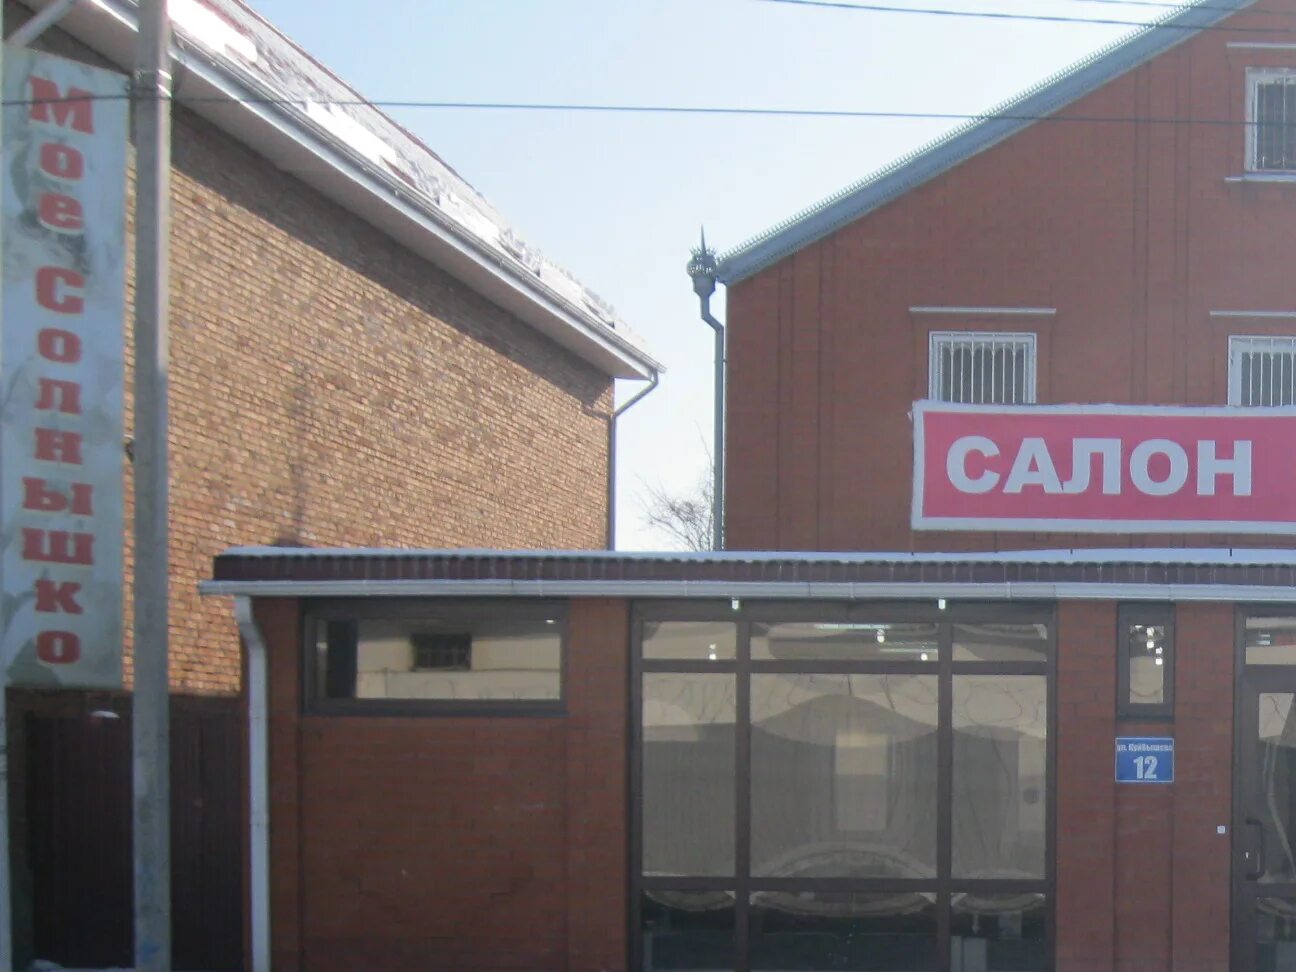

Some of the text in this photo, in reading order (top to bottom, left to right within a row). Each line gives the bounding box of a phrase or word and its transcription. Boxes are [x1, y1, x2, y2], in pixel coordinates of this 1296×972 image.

[21, 74, 96, 666] Мое Солнышко
[945, 434, 1253, 497] САЛОН
[1133, 756, 1158, 779] 12
